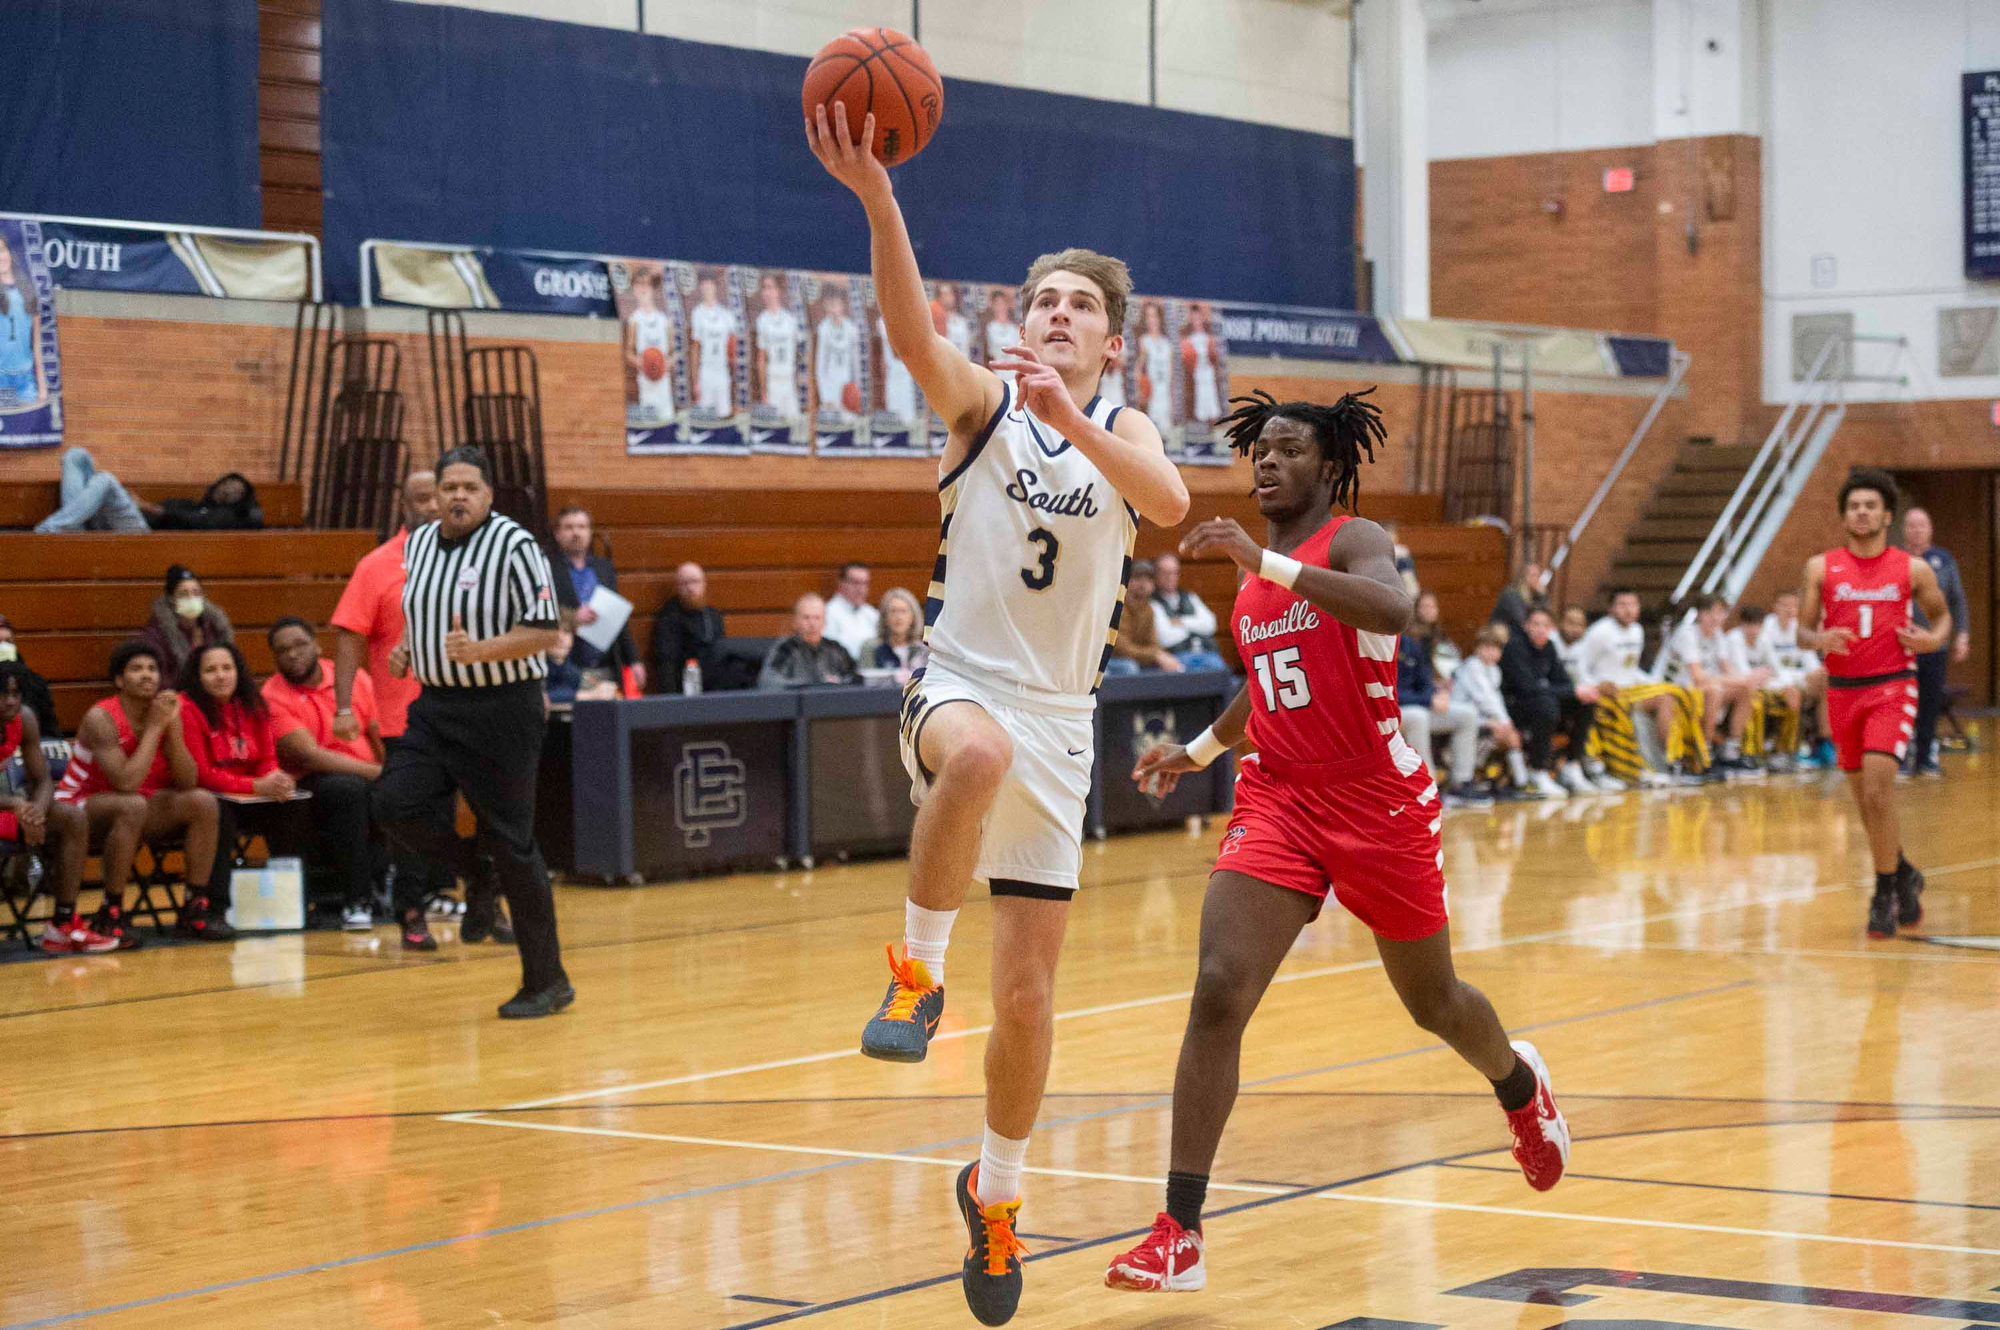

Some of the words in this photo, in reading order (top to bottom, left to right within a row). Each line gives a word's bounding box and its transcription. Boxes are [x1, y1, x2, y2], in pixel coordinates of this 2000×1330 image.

[44, 238, 122, 272] OUTH
[1005, 468, 1098, 518] South
[1020, 526, 1061, 593] 3
[1239, 599, 1320, 646] Roseville
[1858, 604, 1873, 638] 1
[1253, 645, 1312, 713] 15
